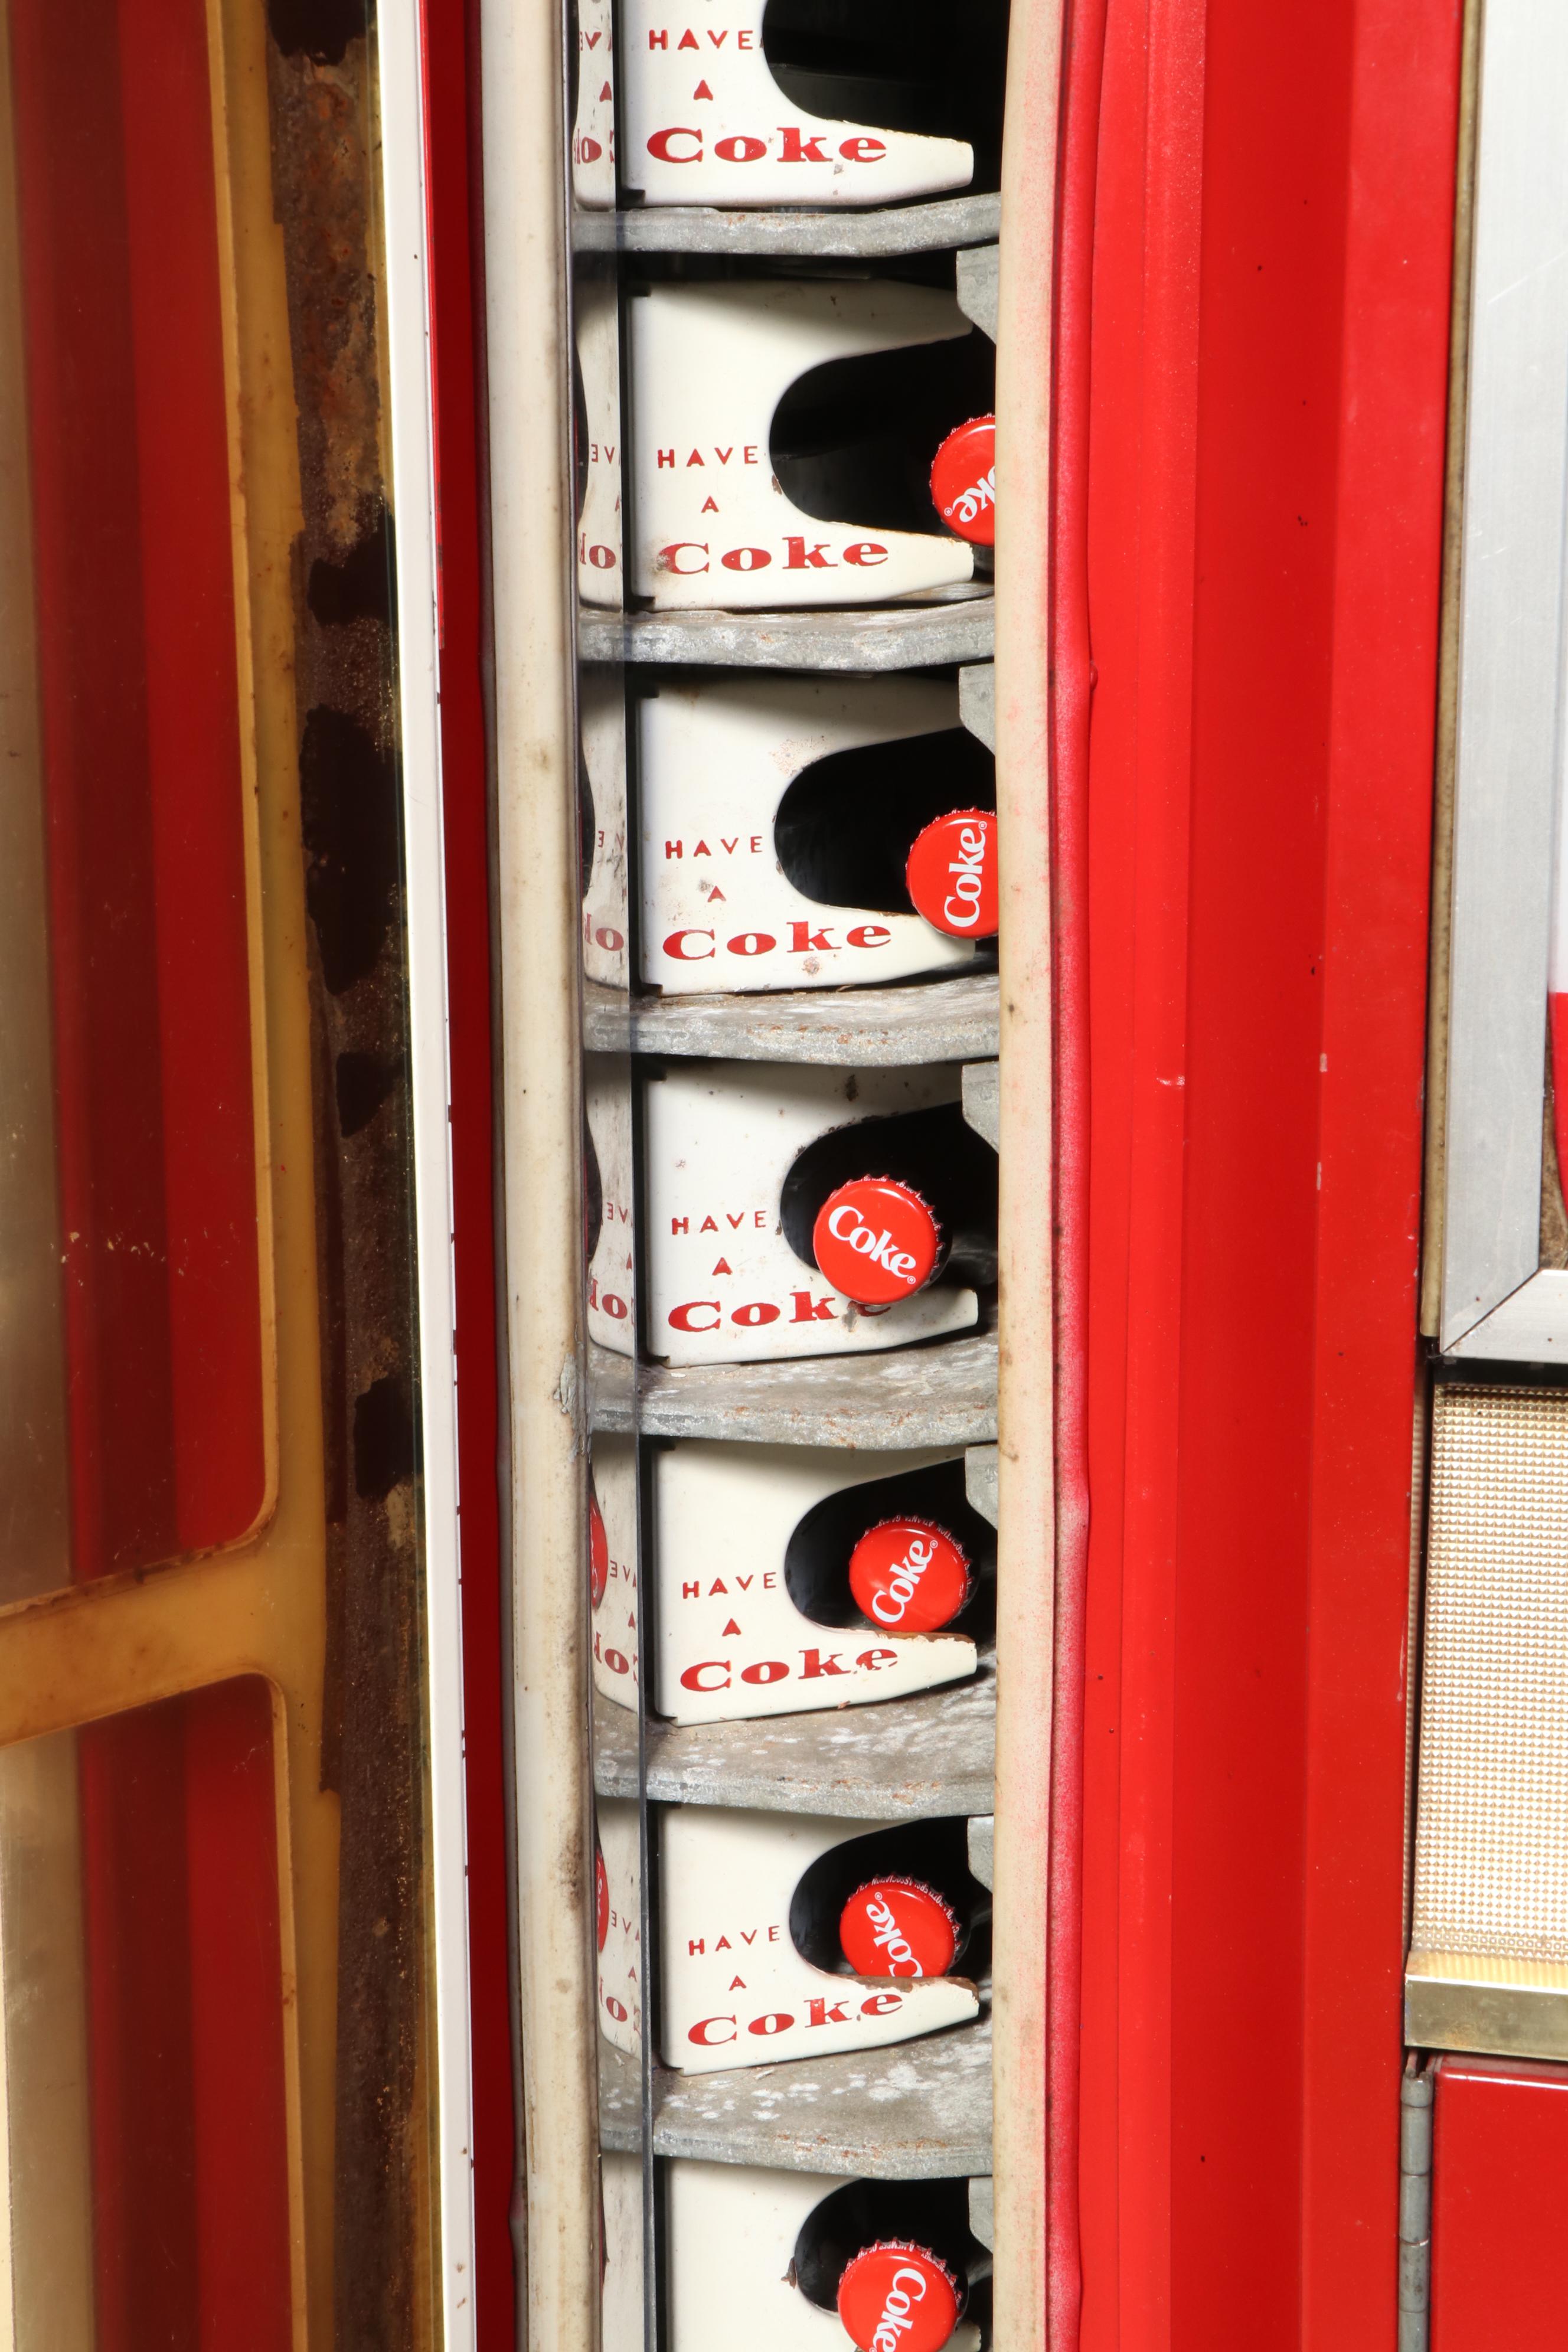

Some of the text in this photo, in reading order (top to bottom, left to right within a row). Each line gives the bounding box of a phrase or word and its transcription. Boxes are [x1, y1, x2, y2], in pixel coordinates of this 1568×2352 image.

[648, 28, 754, 51] HAVE
[692, 79, 714, 101] A
[645, 126, 887, 164] Coke
[656, 445, 759, 469] HAVE
[700, 495, 719, 513] A
[658, 535, 888, 576] Coke
[664, 835, 763, 860] HAVE
[707, 885, 727, 903] A
[662, 920, 892, 961] Coke
[671, 1210, 766, 1236] HAVE
[712, 1256, 733, 1276] A
[682, 1572, 777, 1600] HAVE
[721, 1618, 742, 1638] A
[680, 1648, 899, 1693] Coke
[687, 1925, 780, 1956] HAVE
[729, 1975, 747, 1991] A
[687, 1994, 904, 2046] Coke
